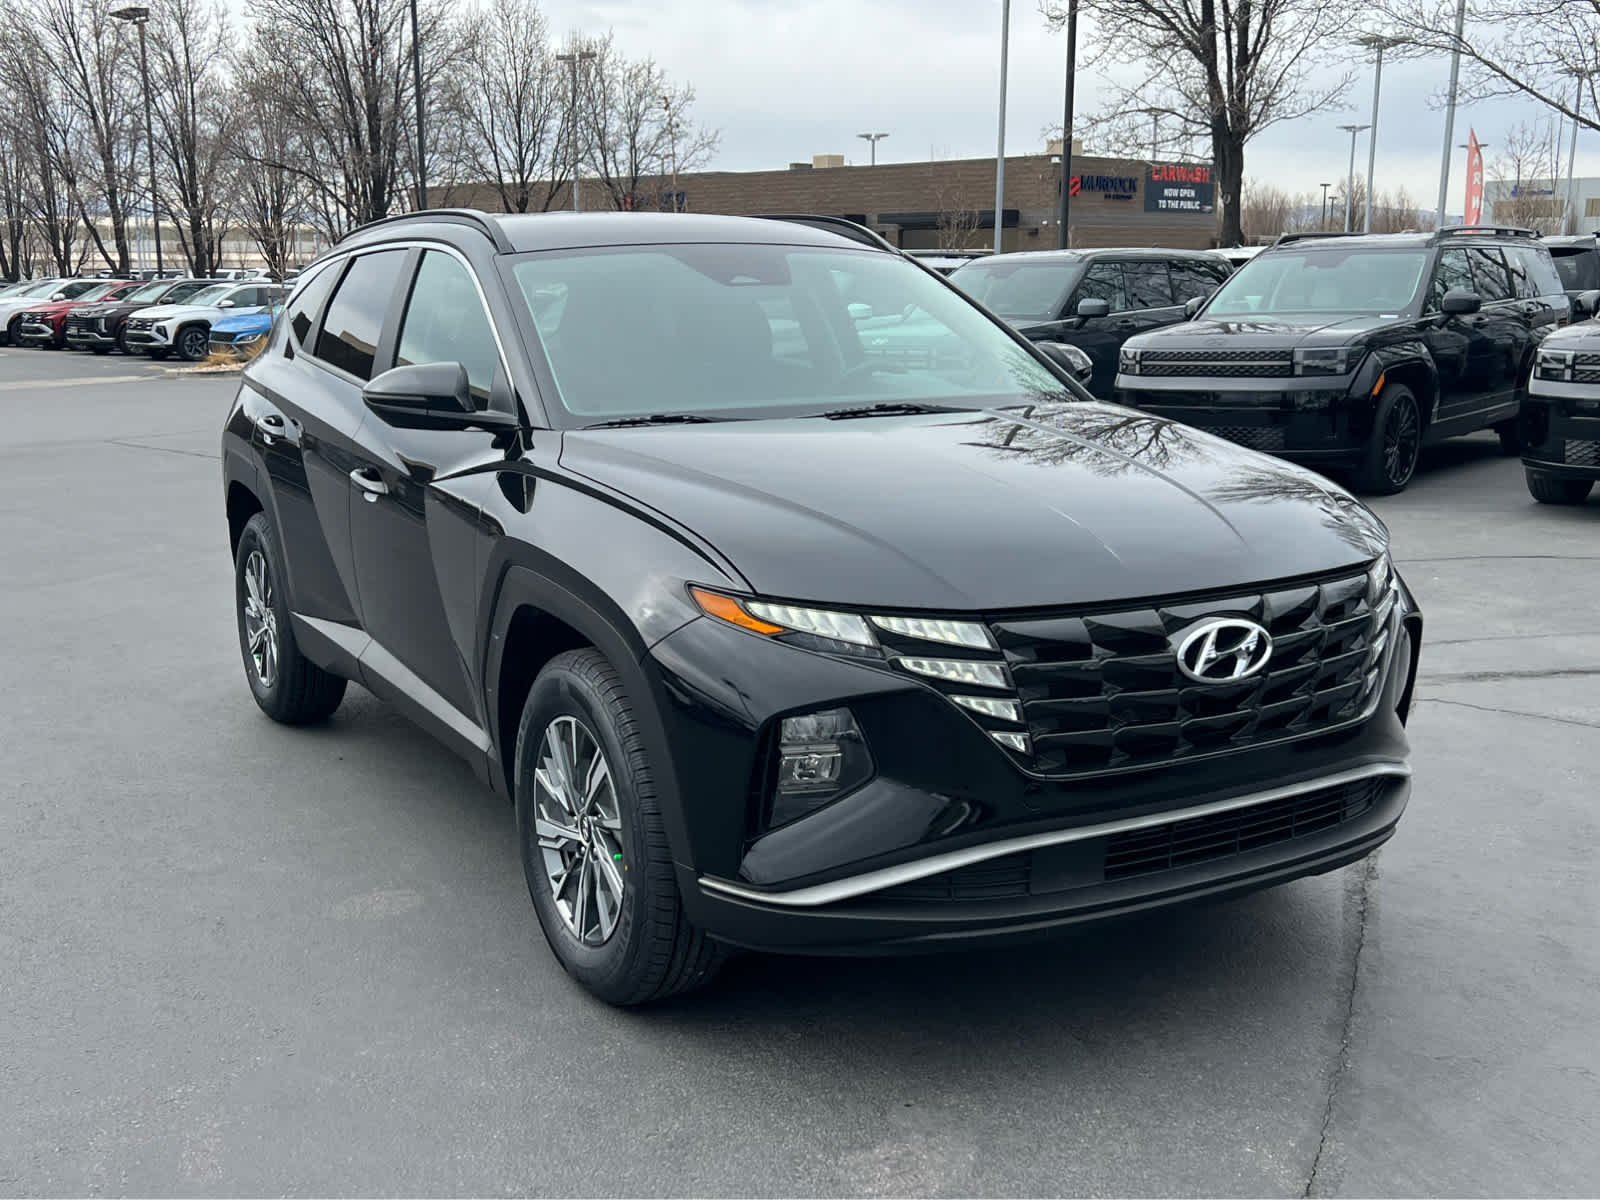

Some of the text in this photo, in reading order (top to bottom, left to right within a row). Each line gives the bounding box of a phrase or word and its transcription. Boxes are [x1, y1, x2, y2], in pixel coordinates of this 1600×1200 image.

[1164, 188, 1195, 197] NOW OPEN
[1158, 200, 1200, 209] TO THE PUBLIC
